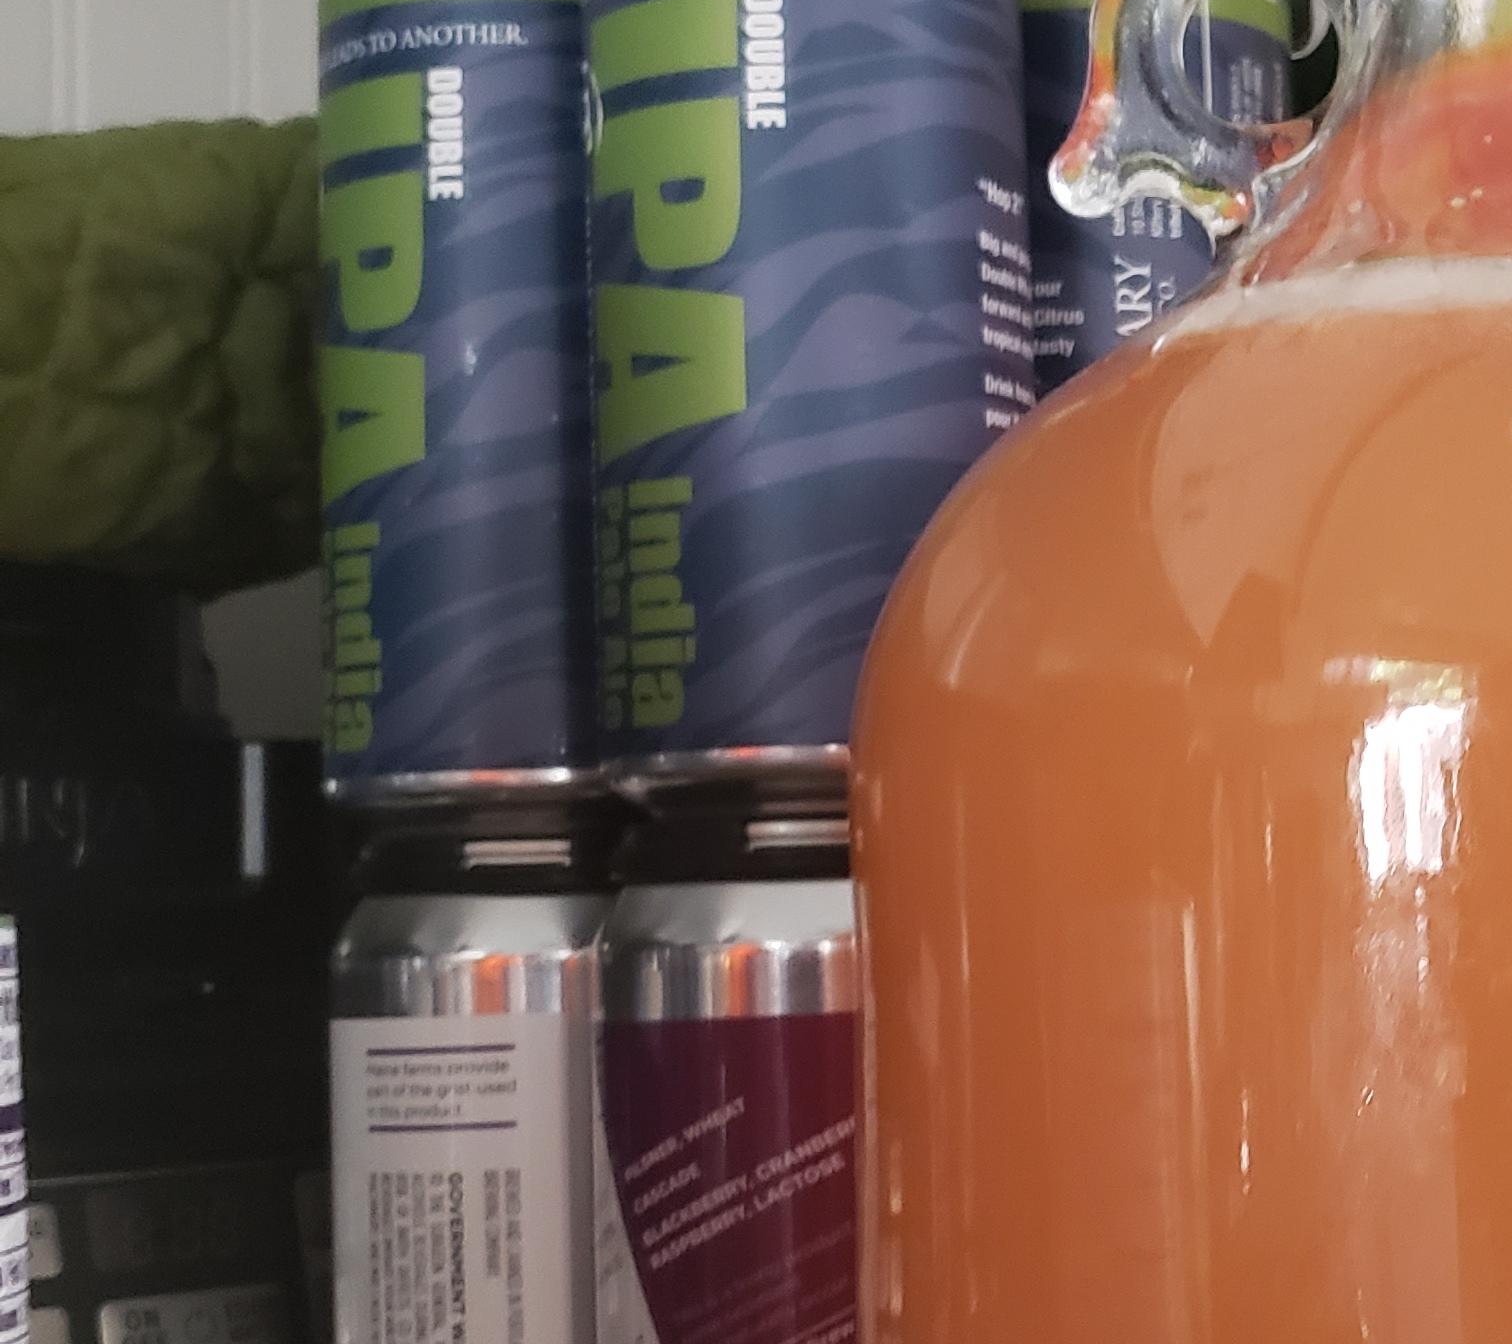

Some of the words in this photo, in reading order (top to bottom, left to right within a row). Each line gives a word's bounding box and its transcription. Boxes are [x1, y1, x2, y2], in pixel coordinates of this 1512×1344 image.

[367, 27, 398, 55] TO
[400, 21, 529, 50] ANOTHER.
[426, 66, 465, 201] DOUBLE
[318, 71, 428, 518] IPA
[334, 521, 384, 752] India
[627, 475, 696, 729] India
[448, 1171, 466, 1315] GOVERNMENT
[754, 1151, 846, 1211] LACTOSE
